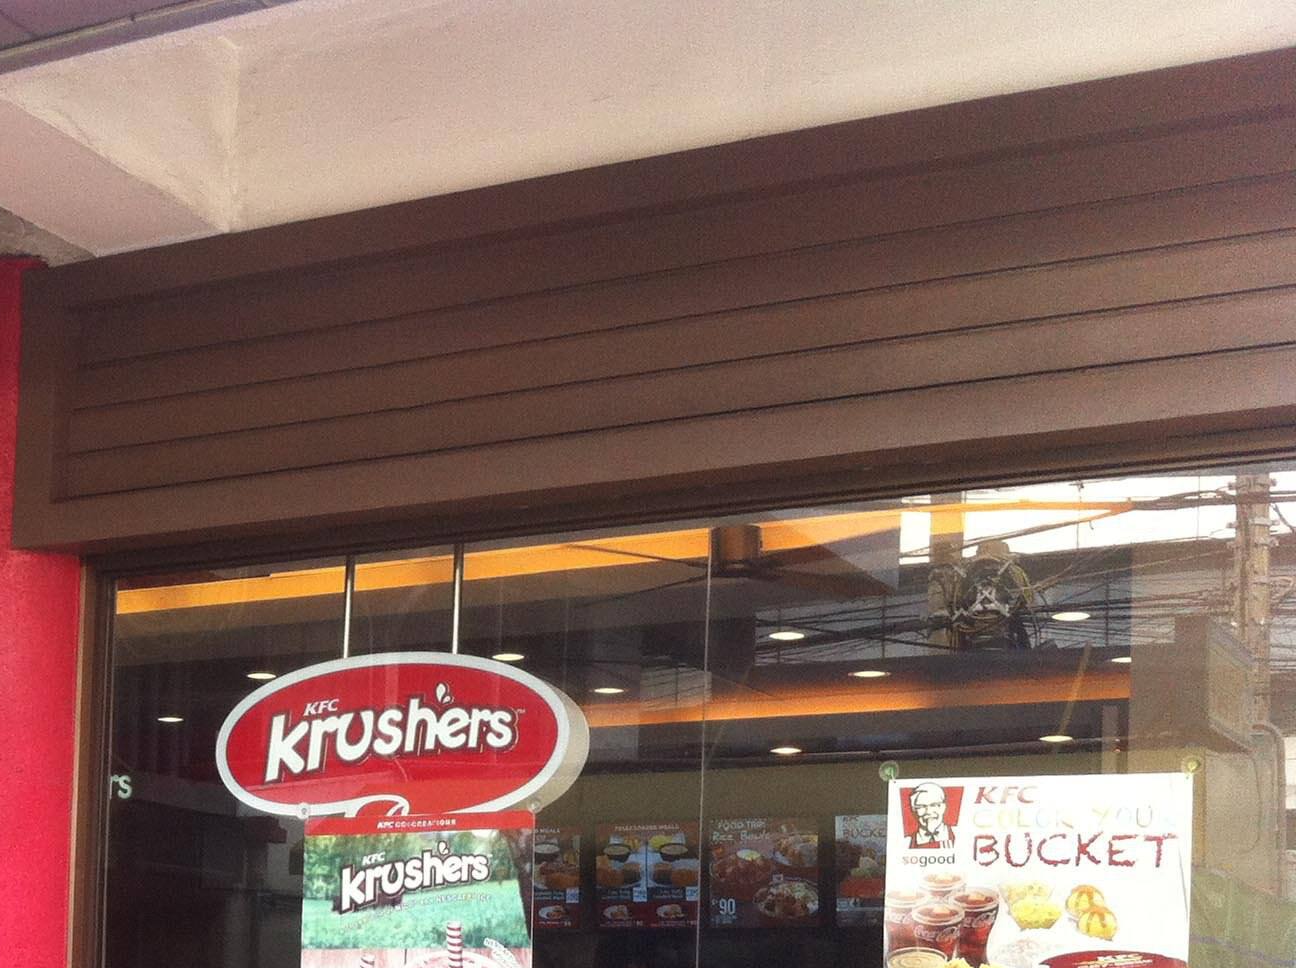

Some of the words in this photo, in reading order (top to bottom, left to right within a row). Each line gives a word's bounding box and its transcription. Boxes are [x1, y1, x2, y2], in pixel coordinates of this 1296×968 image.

[303, 698, 340, 717] KFC
[973, 785, 1038, 804] KFC
[1096, 804, 1178, 829] YOU
[362, 852, 386, 866] KFC
[973, 831, 1179, 868] BUCKET
